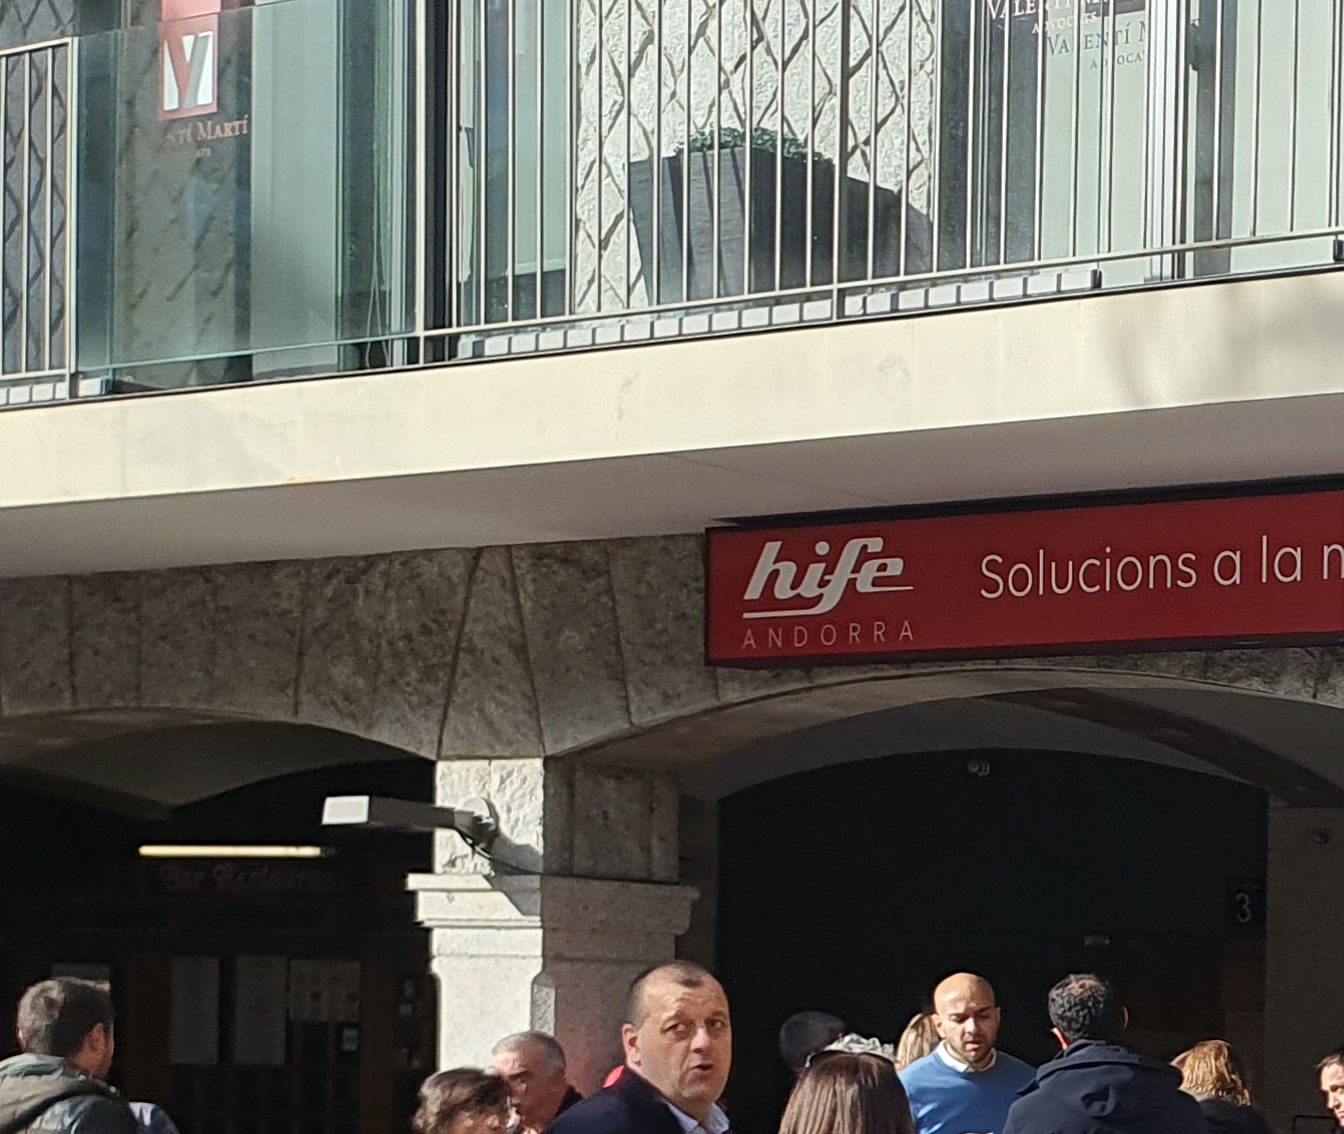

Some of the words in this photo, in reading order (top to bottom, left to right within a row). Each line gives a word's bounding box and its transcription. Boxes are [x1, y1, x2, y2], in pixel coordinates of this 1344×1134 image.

[742, 537, 914, 618] hife
[979, 546, 1198, 600] Solucions
[1212, 549, 1241, 586] a
[1260, 535, 1302, 583] la
[742, 620, 914, 650] ANDORRA
[1235, 892, 1251, 923] 3
